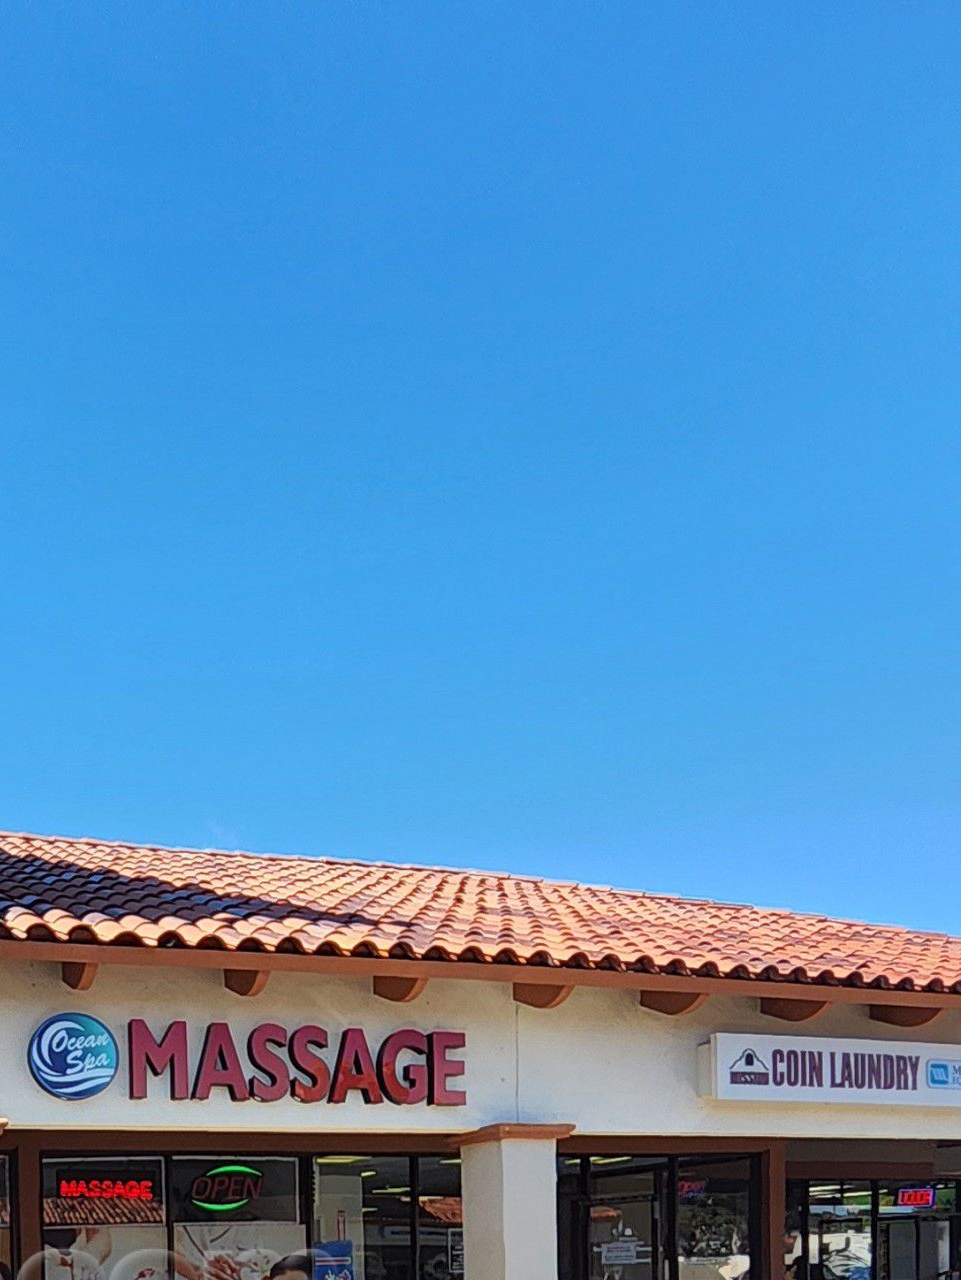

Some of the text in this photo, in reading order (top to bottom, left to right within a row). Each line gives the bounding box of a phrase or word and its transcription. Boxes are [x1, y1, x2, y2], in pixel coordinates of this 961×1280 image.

[51, 1029, 110, 1052] Ocean
[65, 1049, 111, 1074] Spa
[128, 1018, 466, 1106] MASSAGE
[771, 1049, 921, 1091] COIN LAUNDRY
[60, 1180, 154, 1200] MASSAGE
[192, 1176, 263, 1199] OPEN
